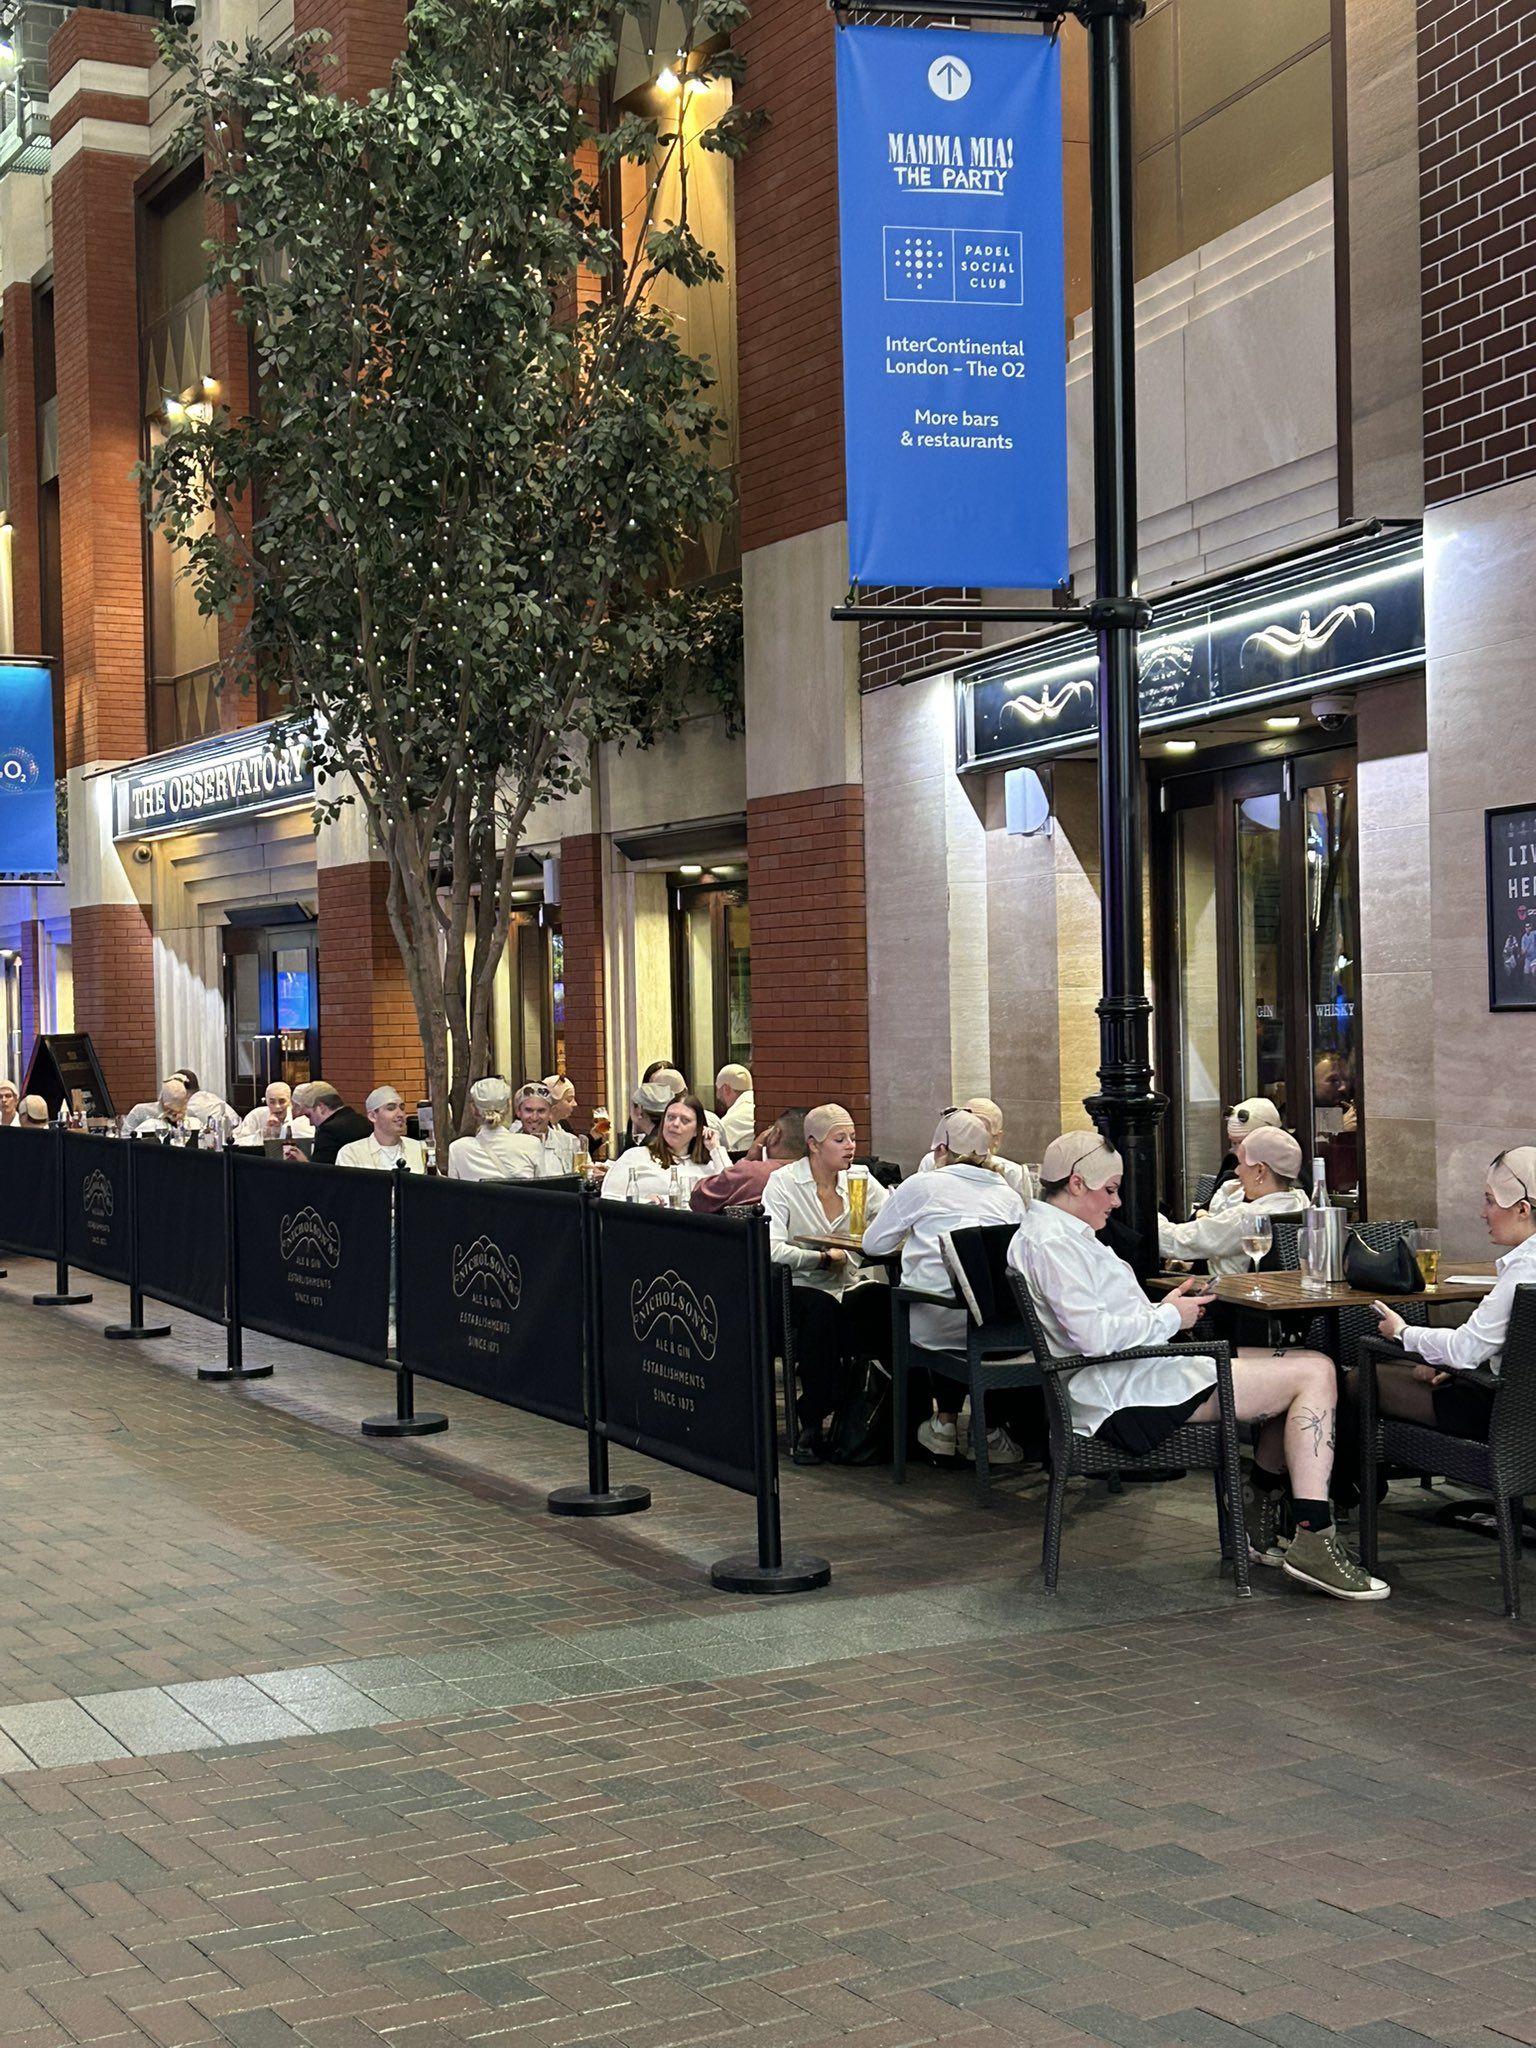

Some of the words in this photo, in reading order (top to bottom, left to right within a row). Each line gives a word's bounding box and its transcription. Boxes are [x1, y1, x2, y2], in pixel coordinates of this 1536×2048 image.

[888, 133, 963, 166] MAMMA
[970, 137, 1013, 168] MIA!
[893, 167, 931, 186] THE
[942, 168, 1007, 189] PARTY
[965, 245, 1010, 257] PADEL
[961, 261, 1015, 273] SOCIAL
[970, 277, 1006, 289] CLUB
[886, 335, 1025, 356] InterContinental
[885, 358, 949, 375] London
[966, 360, 998, 377] The
[915, 409, 958, 426] More
[962, 410, 999, 427] bars
[901, 431, 913, 447] &
[917, 434, 1013, 449] restaurants
[132, 781, 166, 820] THE
[169, 742, 304, 813] OBSERVATORY
[1256, 1005, 1275, 1018] GIN
[1315, 1003, 1355, 1017] WHISKY
[459, 1311, 511, 1334] ESTABLISHMENTS
[468, 1335, 487, 1350] SINCE
[655, 1338, 669, 1353] ALE
[677, 1344, 691, 1359] GIN
[642, 1359, 706, 1390] ESTABLISHMENTS
[653, 1388, 676, 1407] SINCE
